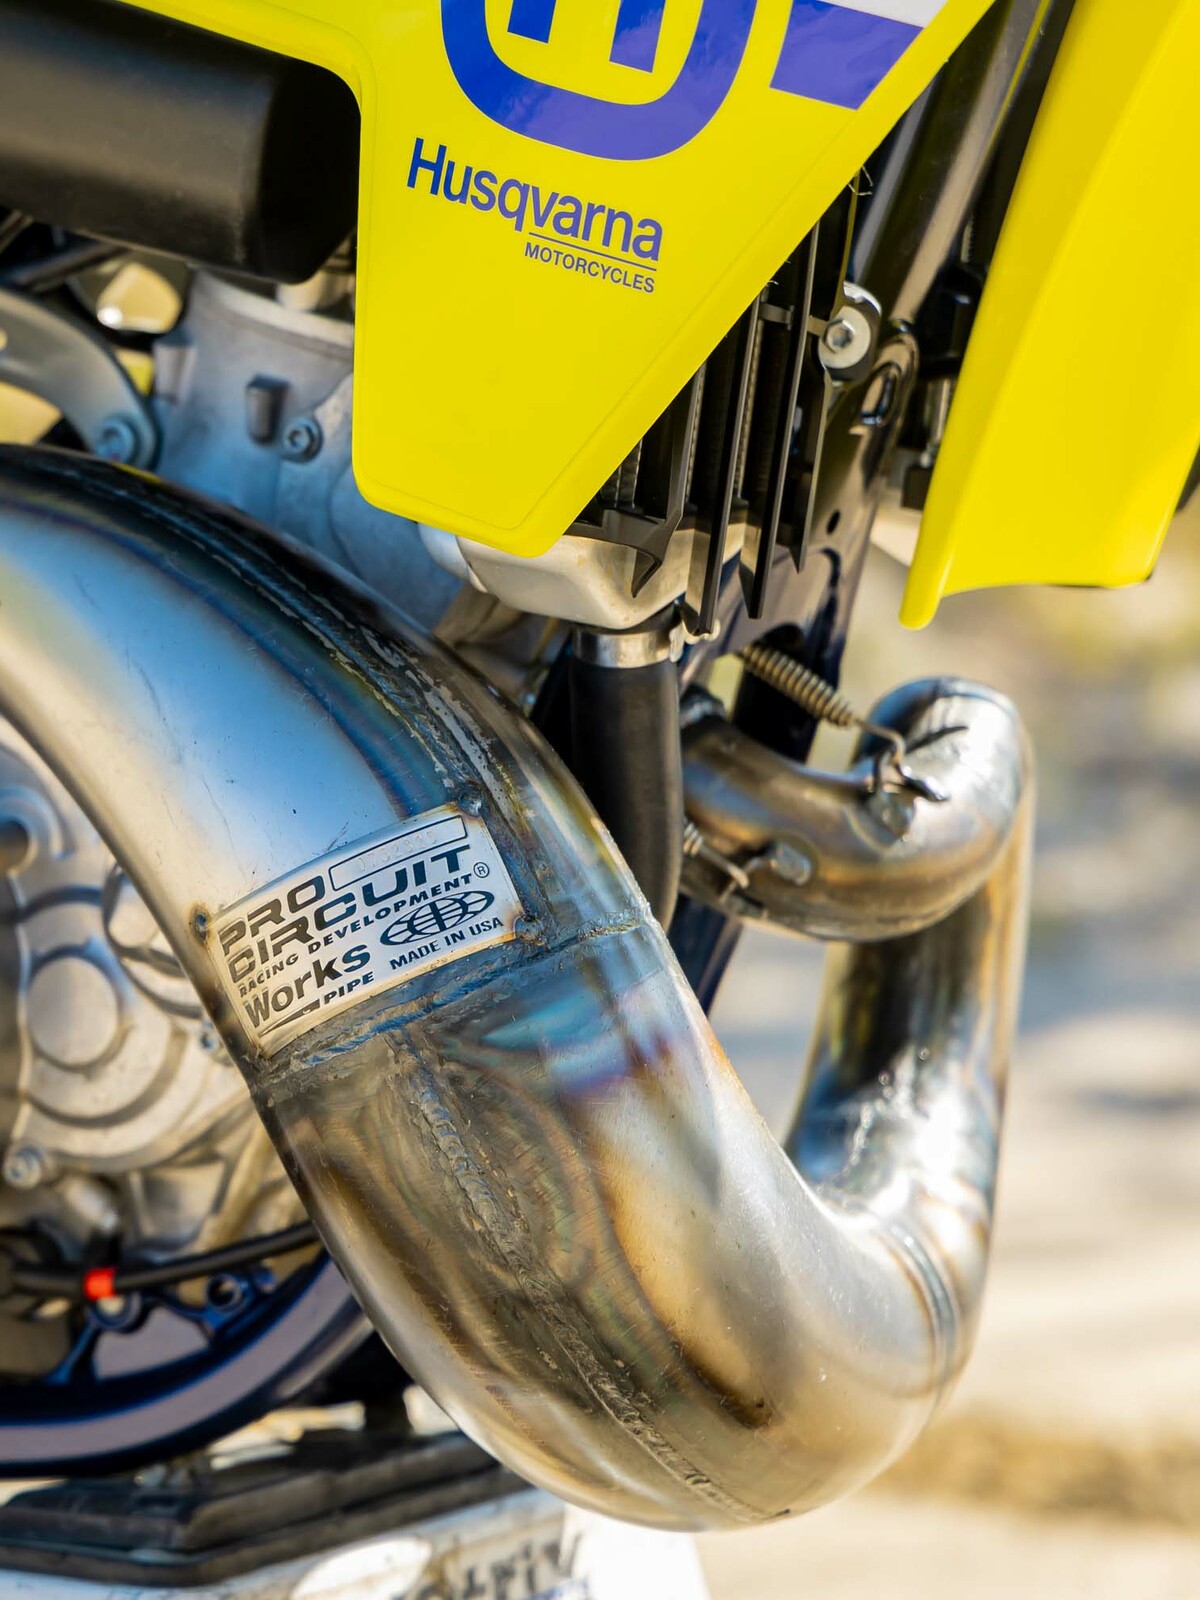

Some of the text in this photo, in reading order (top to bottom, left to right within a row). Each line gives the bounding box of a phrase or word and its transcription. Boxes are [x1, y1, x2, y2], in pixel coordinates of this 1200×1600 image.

[407, 137, 664, 262] Husqvarna
[524, 241, 656, 294] MOTORCYCLES
[218, 874, 326, 956] PRO
[228, 844, 471, 983] CIRCUIT
[238, 954, 299, 998] RACING
[308, 873, 472, 955] DEVELOPMENT
[389, 916, 505, 971] MADE IN USA
[324, 971, 375, 1006] PIPE
